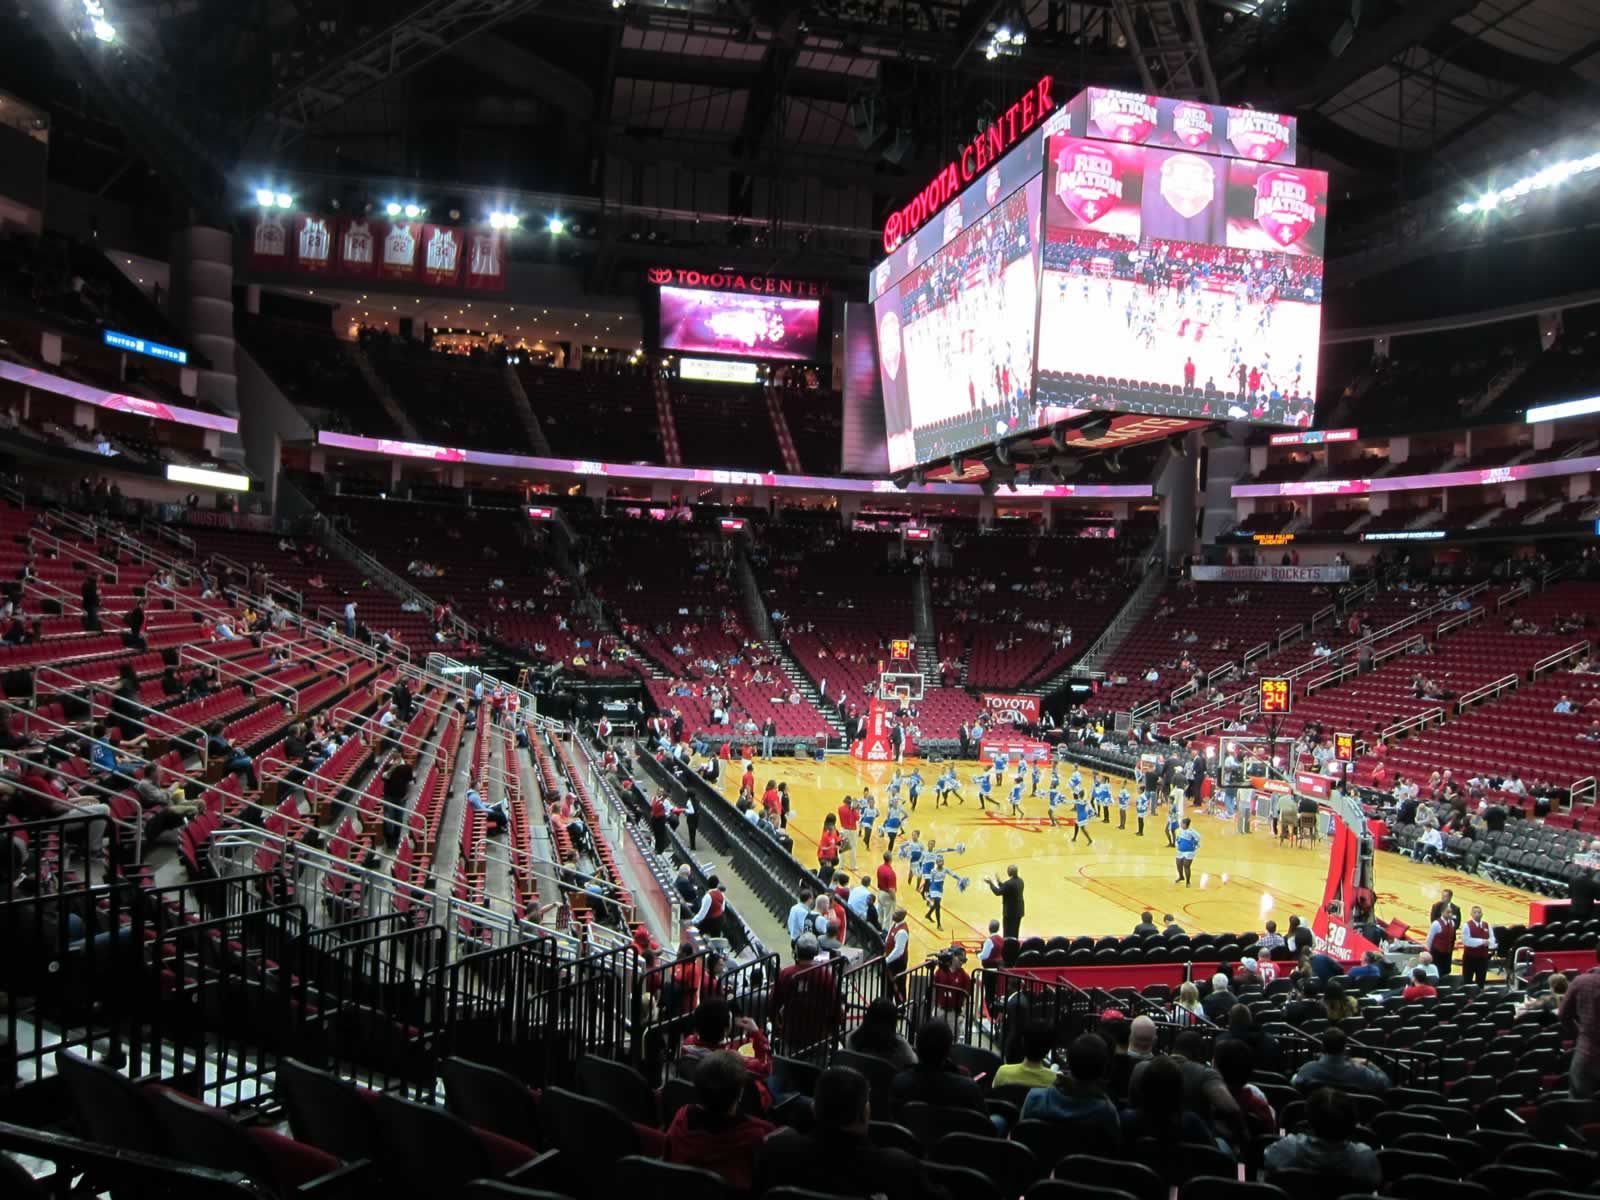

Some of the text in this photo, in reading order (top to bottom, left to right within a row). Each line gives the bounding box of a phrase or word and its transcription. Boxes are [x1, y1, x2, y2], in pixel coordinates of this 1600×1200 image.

[902, 161, 960, 228] TOYOTA
[961, 75, 1054, 182] CENTER
[1074, 153, 1113, 176] RED
[1056, 170, 1122, 199] NATION
[1271, 180, 1307, 202] RED
[1254, 196, 1316, 223] NATION
[392, 240, 406, 252] 22
[676, 269, 747, 290] TOYOTA
[105, 334, 136, 349] UNITED
[151, 345, 179, 360] UNITED
[1271, 567, 1321, 580] ROCKETS
[984, 697, 1036, 711] TOYOTA
[1263, 693, 1285, 710] 24
